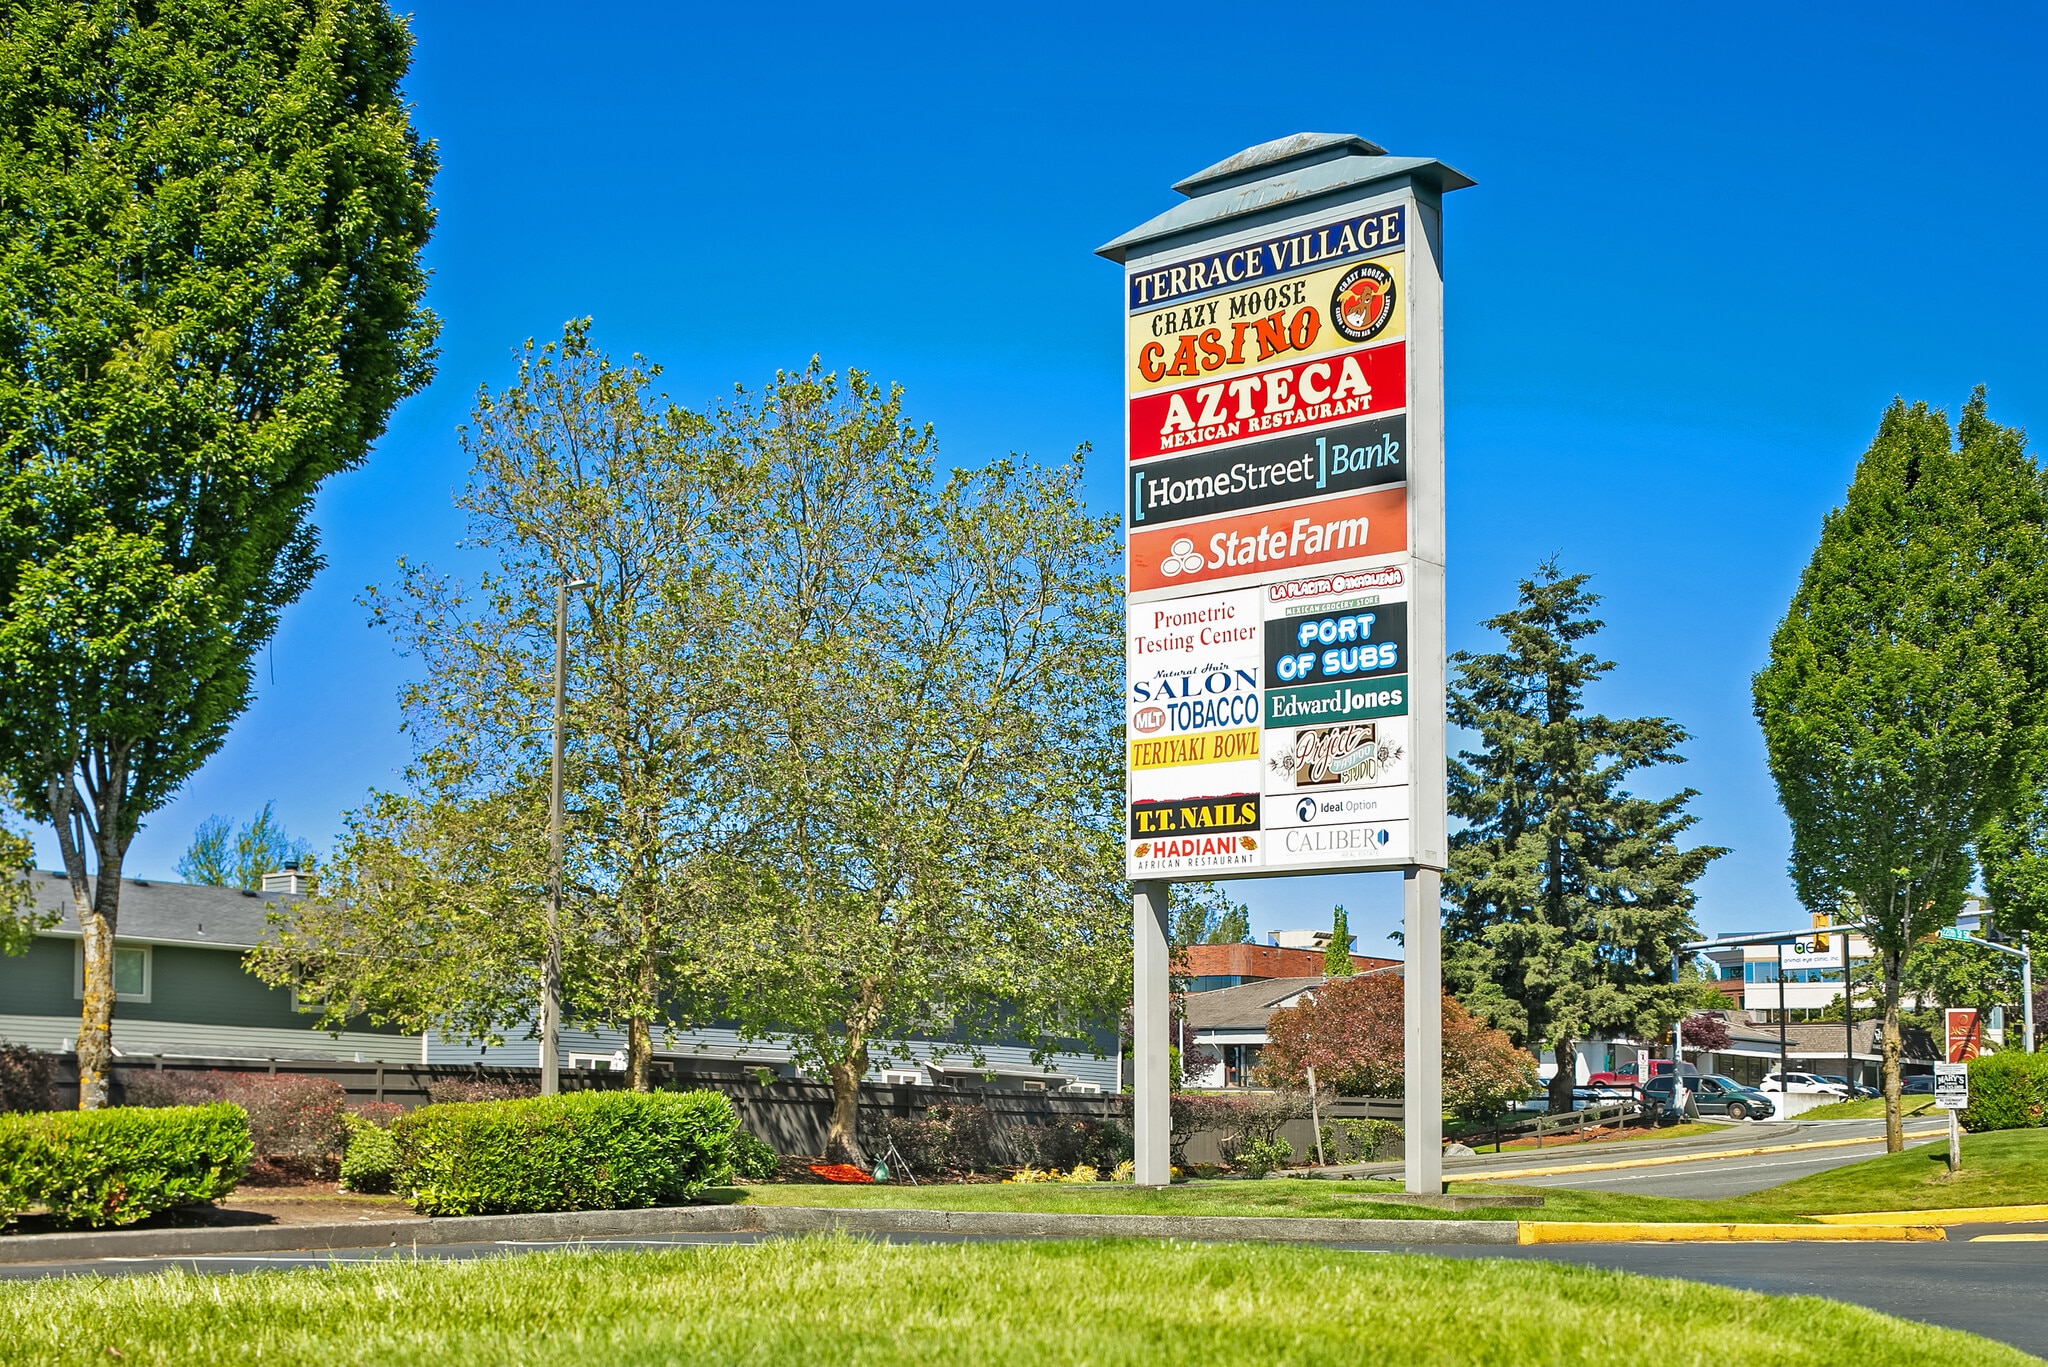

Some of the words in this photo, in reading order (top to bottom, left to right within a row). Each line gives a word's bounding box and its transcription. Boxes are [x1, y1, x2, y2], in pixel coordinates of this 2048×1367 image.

[1135, 246, 1263, 304] TERRACE
[1269, 212, 1401, 268] VILLAGE
[1339, 270, 1359, 292] CRAZY
[1361, 268, 1385, 281] MOOSE
[1152, 301, 1219, 337] CRAZY
[1229, 280, 1307, 320] MOOSE
[1138, 305, 1322, 383] CASINO
[1160, 356, 1372, 435] AZTECA
[1160, 421, 1240, 450] MEXICAN
[1248, 395, 1372, 433] RESTAURANT
[1331, 433, 1400, 476] Bank
[1271, 585, 1287, 600] LA
[1287, 579, 1332, 598] PLACITA
[1154, 602, 1236, 630] Prometric
[1286, 606, 1321, 616] MEXICAN
[1321, 601, 1354, 612] GROCERY
[1356, 595, 1380, 606] STORE
[1135, 633, 1194, 655] Testing
[1200, 626, 1256, 646] Center
[1298, 613, 1376, 647] PORT
[1153, 667, 1197, 679] Natural
[1201, 662, 1230, 674] Hair
[1277, 654, 1317, 681] OF
[1322, 642, 1398, 675] SUBS
[1133, 667, 1259, 703] SALON
[1135, 711, 1163, 729] MLT
[1167, 693, 1259, 731] TOBACCO
[1134, 736, 1206, 766] TERIYAKI
[1213, 731, 1259, 759] BOWL
[1333, 745, 1371, 769] TATTOO
[1341, 758, 1376, 784] STUDIO
[1135, 808, 1176, 832] T.T.
[1180, 802, 1257, 830] NAILS
[1320, 801, 1344, 813] Ideal
[1345, 799, 1377, 813] Option
[1153, 836, 1237, 859] HADIANI
[1286, 828, 1378, 853] CALIBER
[1138, 859, 1180, 870] AFRICAN
[1188, 854, 1253, 867] RESTAURANT
[1938, 1075, 1964, 1084] MARY'S
